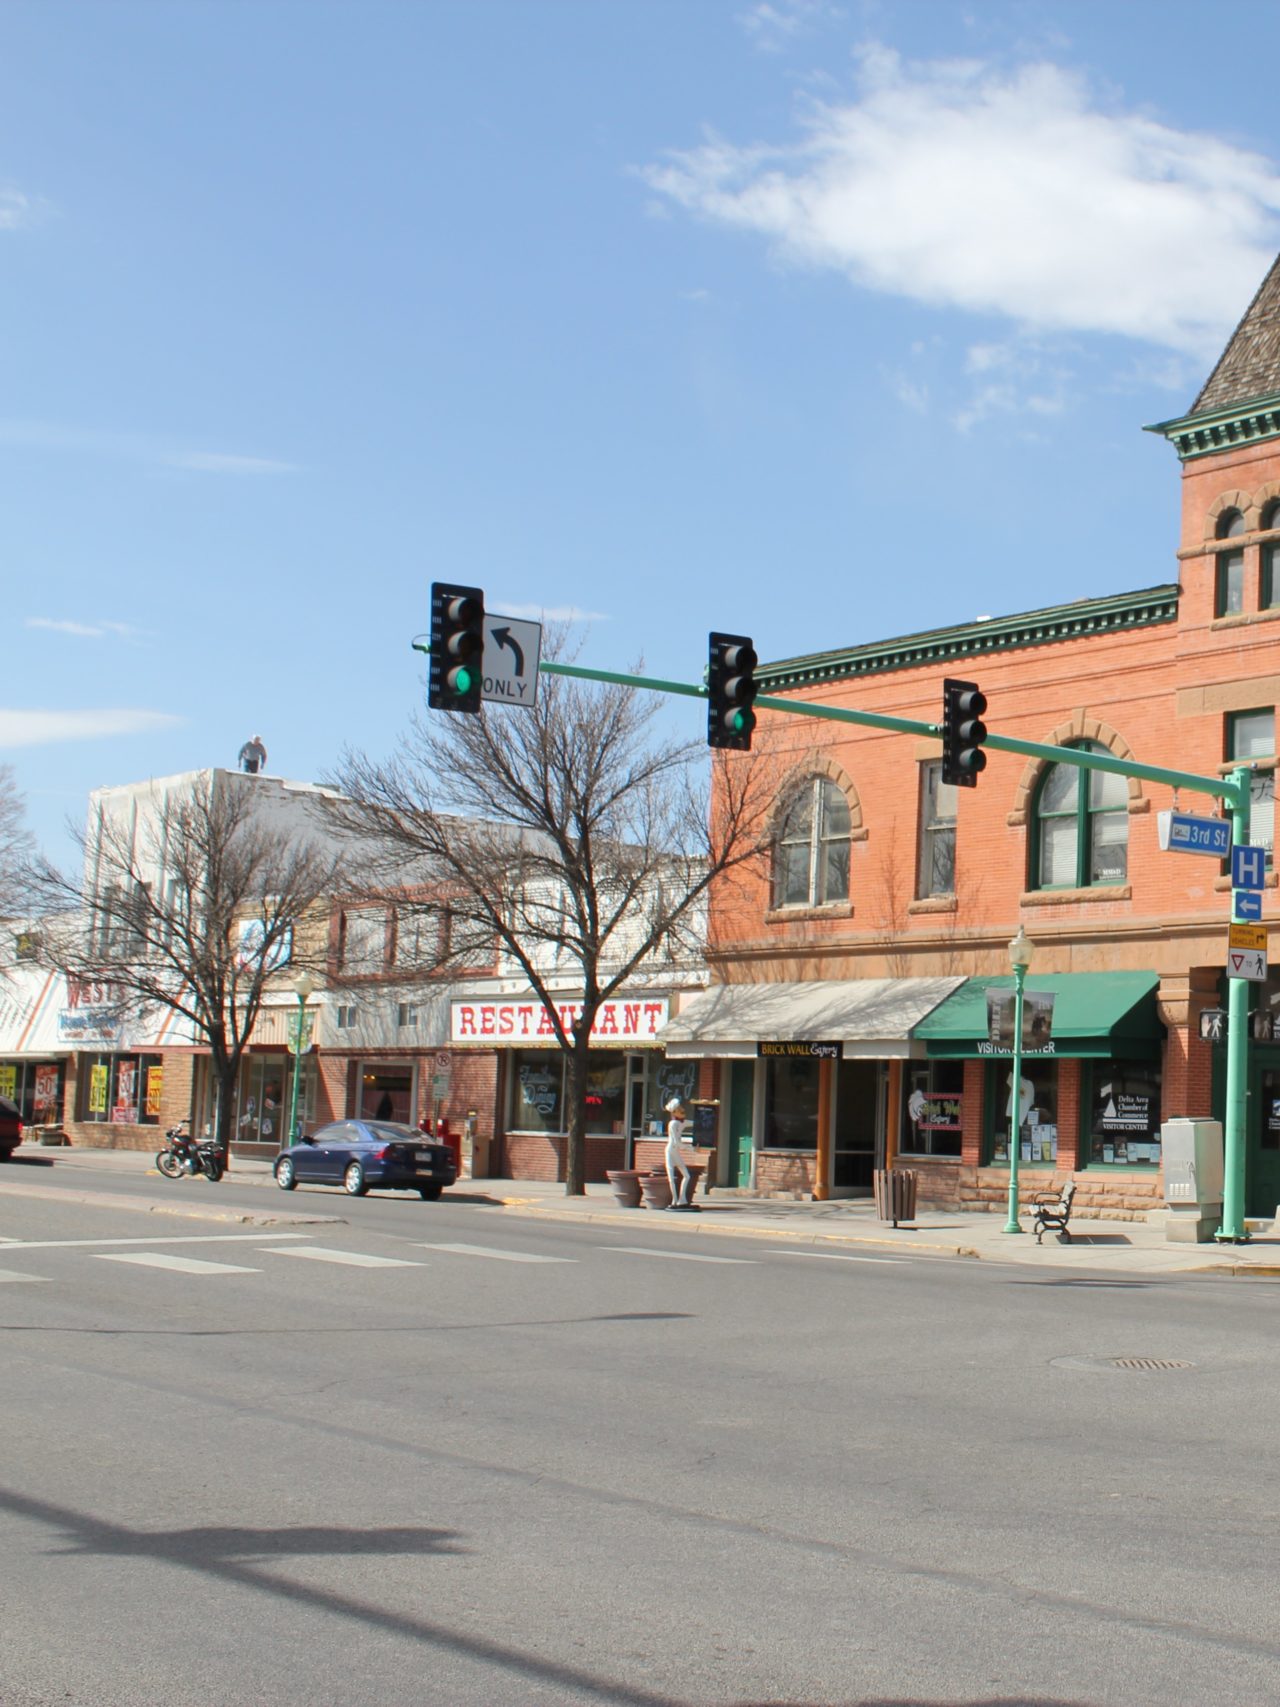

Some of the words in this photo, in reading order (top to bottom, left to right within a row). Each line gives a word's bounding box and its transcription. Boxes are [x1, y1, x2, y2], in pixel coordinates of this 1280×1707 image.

[483, 677, 527, 698] ONLY
[1191, 826, 1210, 845] 3rd
[1214, 829, 1227, 848] St.
[1239, 851, 1258, 885] H
[460, 1004, 662, 1035] RESTAUANT
[761, 1044, 785, 1055] BRICK
[787, 1044, 810, 1055] WALL
[37, 1076, 52, 1095] 50
[1118, 1103, 1139, 1111] Chamber
[1118, 1111, 1149, 1119] Commerce
